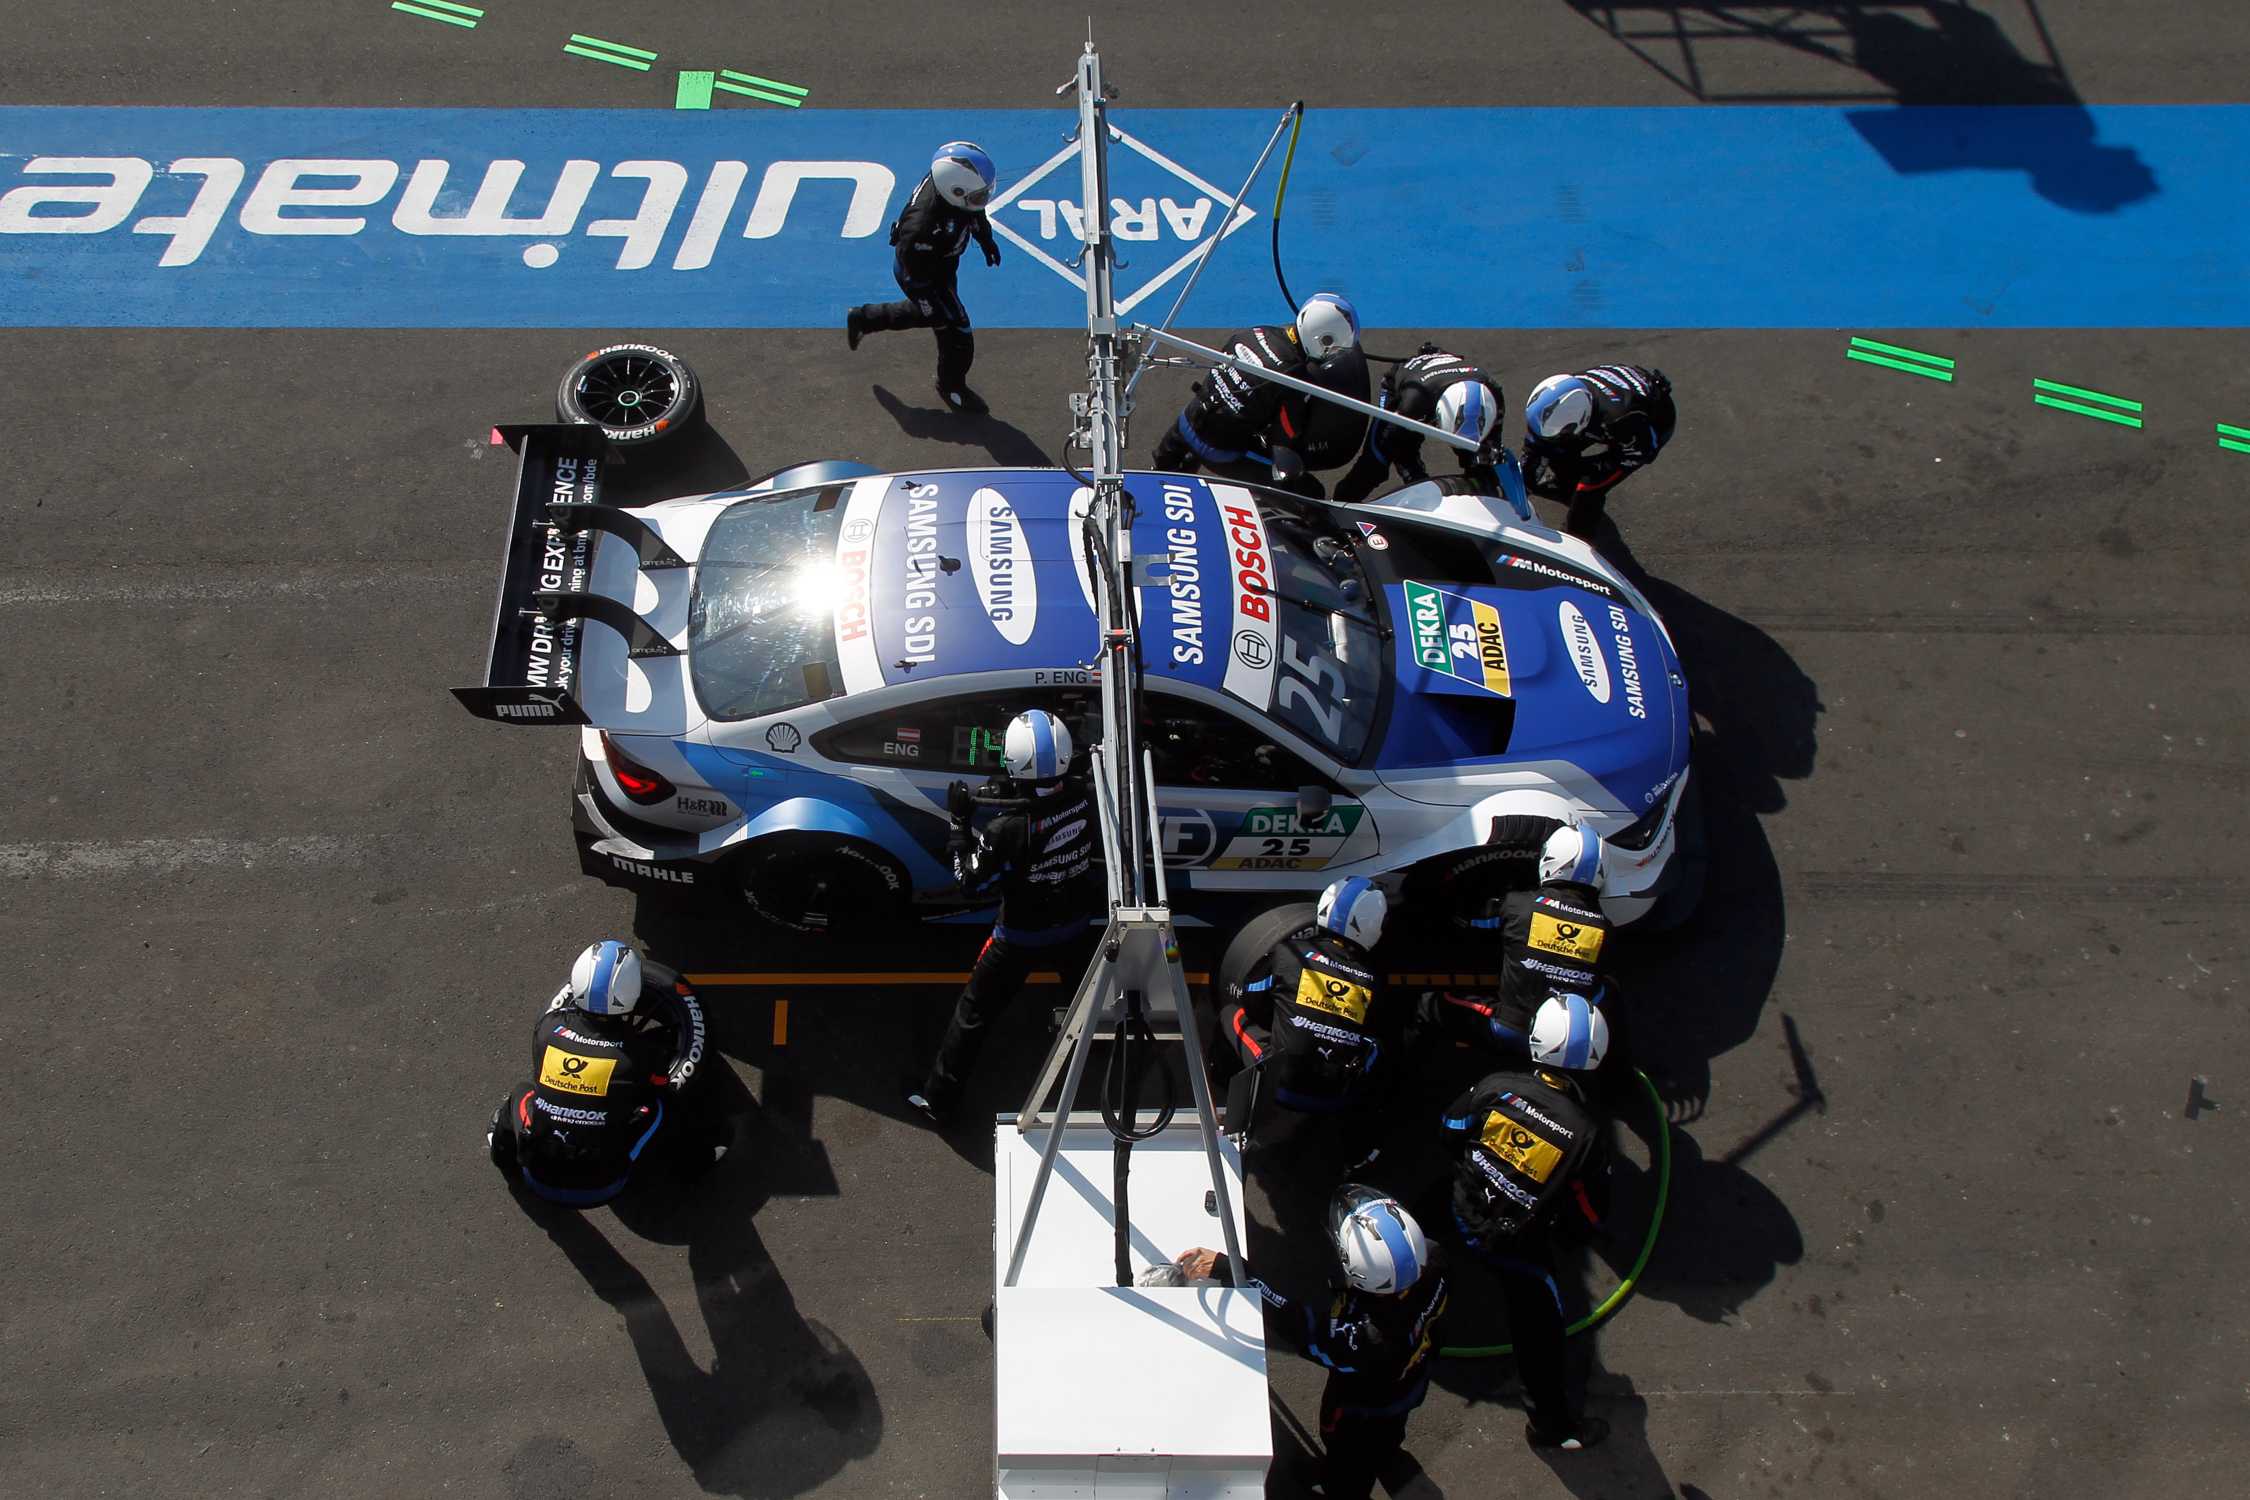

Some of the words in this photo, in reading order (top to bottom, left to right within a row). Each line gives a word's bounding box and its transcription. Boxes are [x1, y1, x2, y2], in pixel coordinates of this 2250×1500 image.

[0, 158, 896, 270] ultimate
[1163, 484, 1195, 523] SDI
[905, 484, 938, 609] SAMSUNG
[989, 506, 1014, 622] SAMSUNG
[1224, 505, 1270, 623] BOSCH
[526, 654, 551, 688] MW
[543, 457, 578, 572] EXPENCE
[568, 568, 586, 592] ning
[1533, 562, 1611, 596] Motorsport
[1166, 528, 1204, 665] SAMSUNG
[560, 616, 577, 646] drive
[1413, 593, 1446, 664] DEKRA
[1607, 605, 1629, 633] SDI
[904, 616, 936, 663] SDI
[1449, 623, 1480, 660] 25
[1477, 622, 1506, 671] ADAC
[1572, 614, 1598, 688] SAMSUNG
[1035, 672, 1048, 684] P.
[1053, 671, 1088, 684] ENG
[1278, 633, 1346, 745] 25
[1615, 634, 1646, 720] SAMSUNG
[496, 704, 555, 718] PUMA
[883, 742, 919, 758] ENG
[968, 727, 1006, 768] 14
[677, 796, 707, 812] H&R
[1251, 813, 1346, 834] DEKA
[1238, 857, 1300, 869] ADAC
[1259, 838, 1311, 857] 25
[612, 856, 694, 884] MAHLE
[1305, 996, 1342, 1014] Deutsche
[574, 1034, 624, 1049] Motorsport
[544, 1075, 577, 1090] Deutsche
[579, 1084, 597, 1093] Post
[1524, 1105, 1575, 1140] Motorsport
